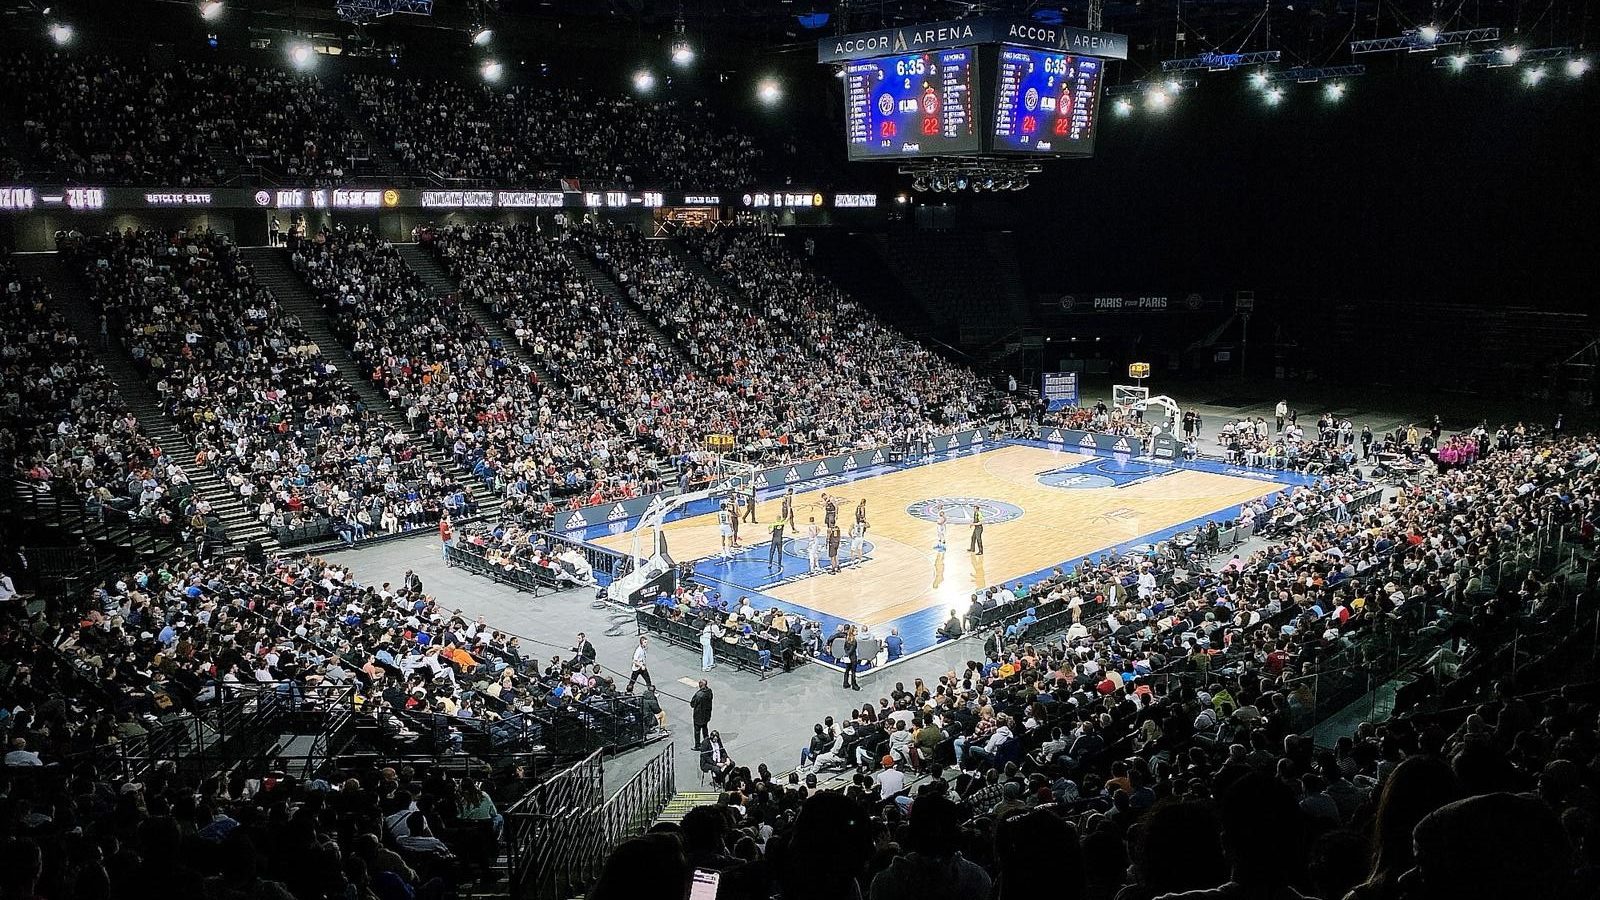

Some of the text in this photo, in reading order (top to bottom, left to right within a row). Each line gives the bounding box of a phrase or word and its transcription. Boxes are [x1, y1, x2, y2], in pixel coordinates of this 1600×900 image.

[834, 25, 974, 54] ACCOR ARENA
[1009, 24, 1115, 50] ACCOR ARENA
[896, 59, 925, 75] 6:35
[930, 64, 937, 75] 2
[1044, 57, 1067, 75] 6:35
[1069, 68, 1075, 78] 2
[878, 70, 884, 80] 3
[1047, 76, 1054, 87] 2
[904, 78, 911, 89] 2
[881, 121, 897, 138] 24
[923, 118, 939, 135] 22
[1023, 116, 1036, 133] 24
[1055, 118, 1068, 134] 22
[147, 194, 211, 203] BETCLIC ELITE
[1094, 297, 1123, 309] PARIS
[1139, 297, 1168, 308] PARIS
